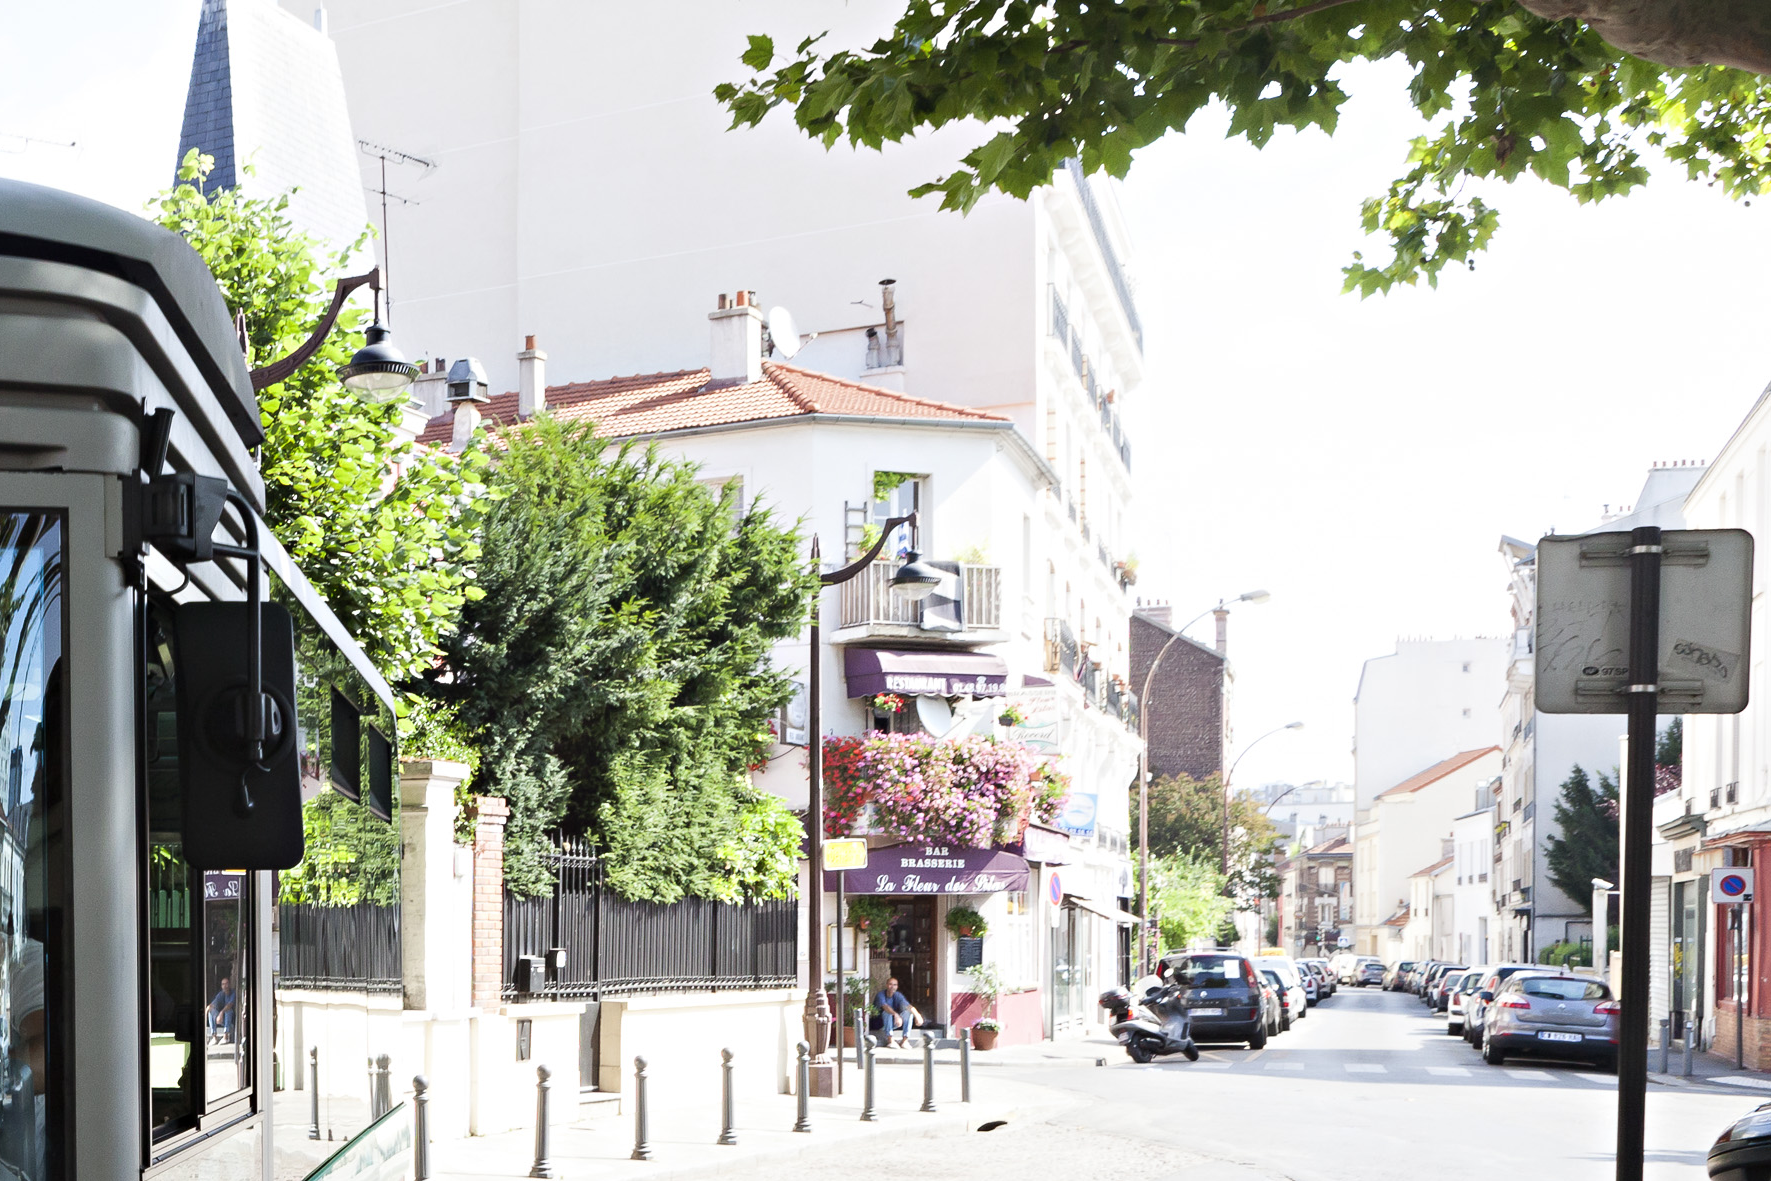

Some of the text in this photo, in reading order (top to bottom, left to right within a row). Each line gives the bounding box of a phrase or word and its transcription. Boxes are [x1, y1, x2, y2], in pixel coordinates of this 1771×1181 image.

[886, 675, 947, 691] RESTAURANT
[925, 846, 949, 856] BAR
[900, 858, 965, 868] BRASSERIE
[875, 874, 1007, 892] La Fleur des Lilas
